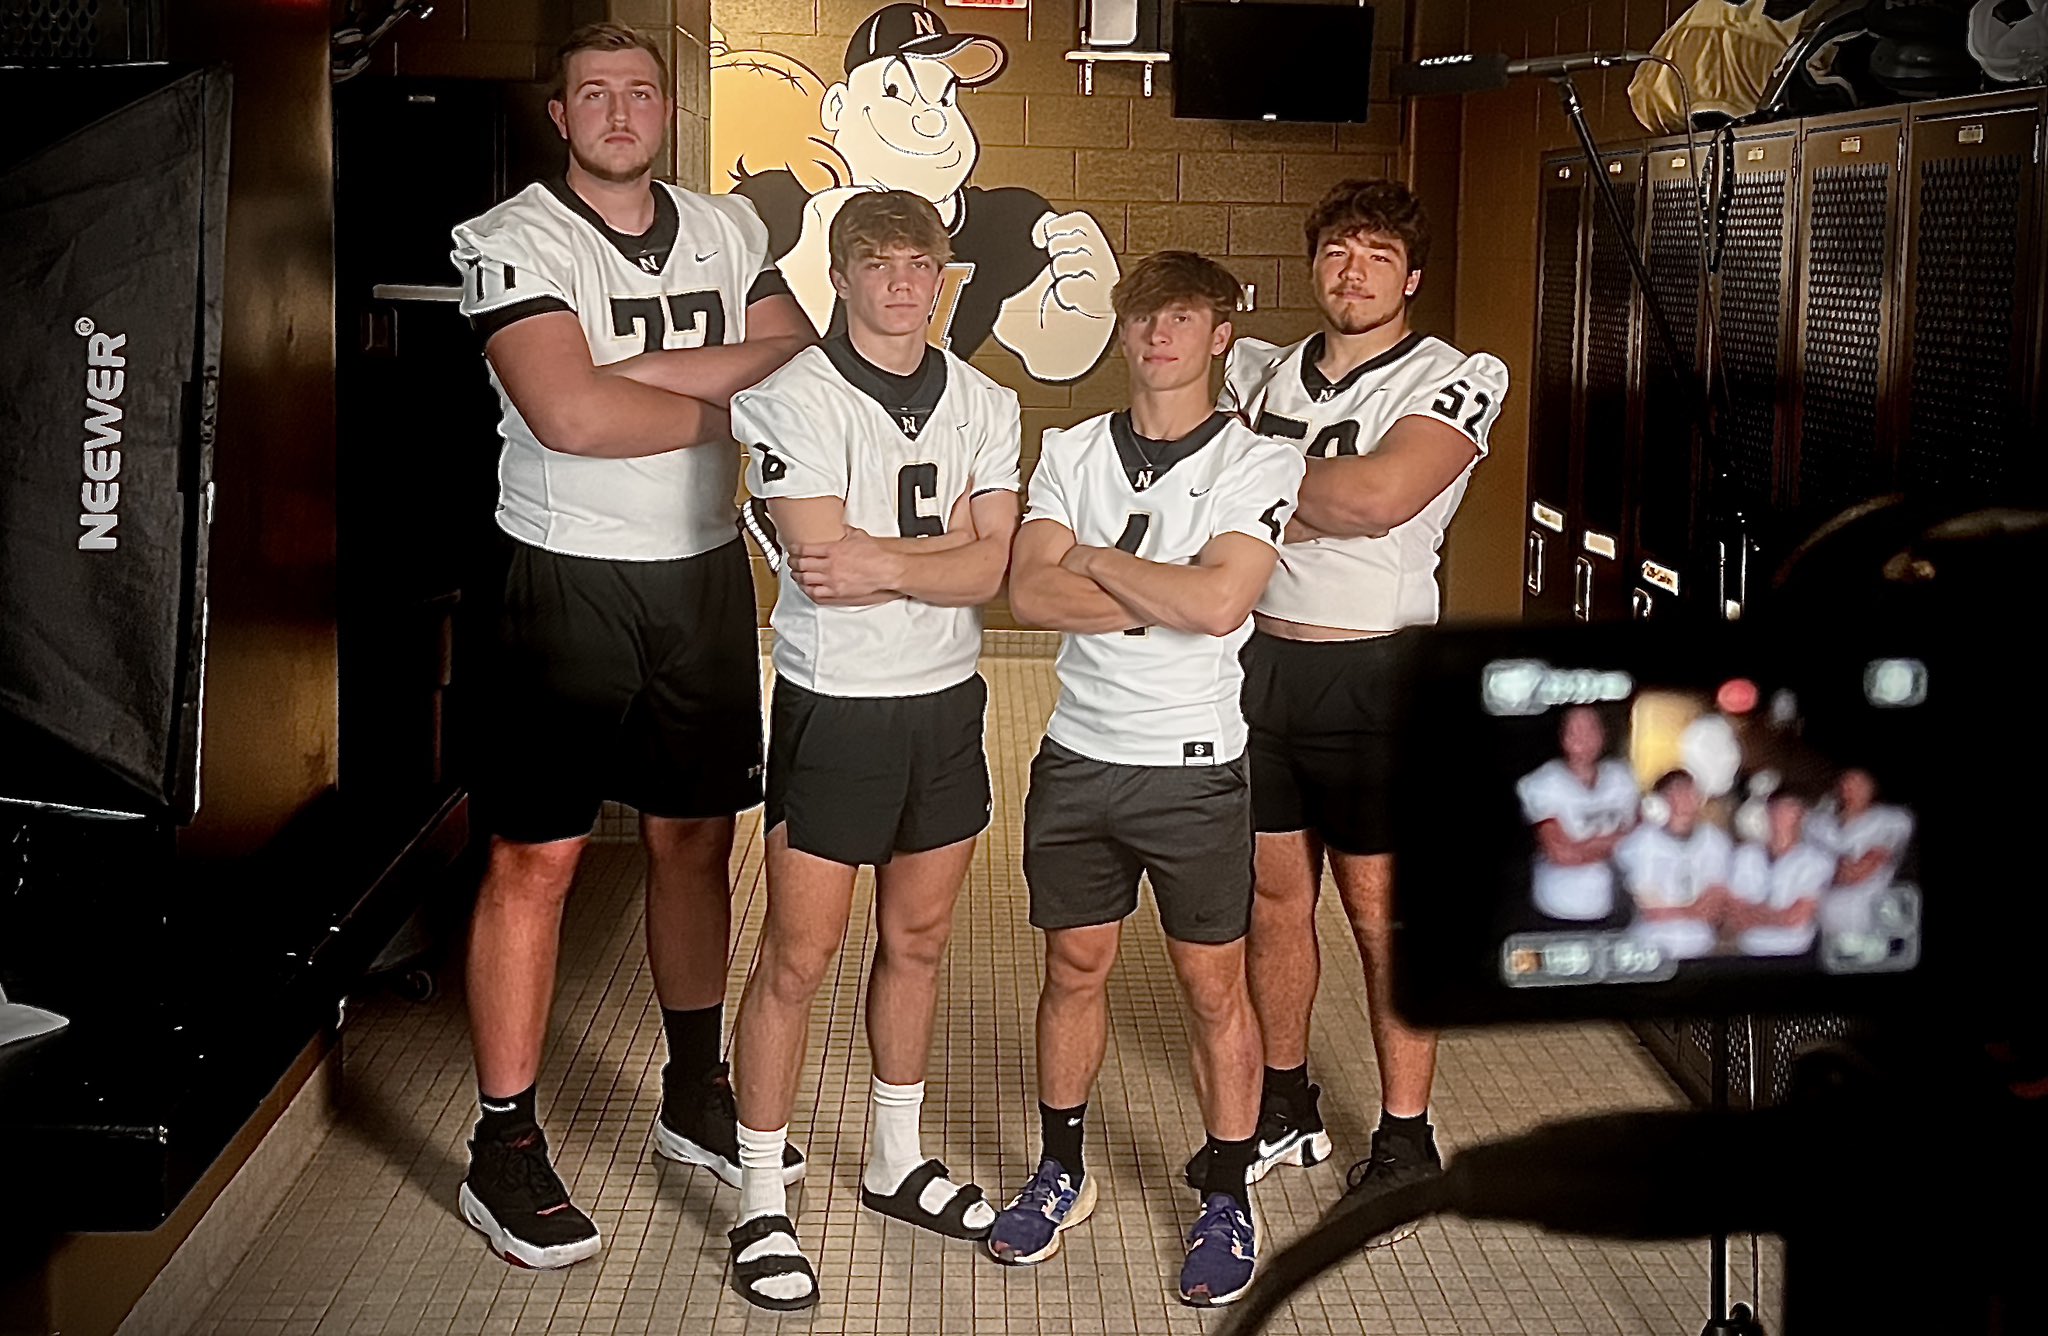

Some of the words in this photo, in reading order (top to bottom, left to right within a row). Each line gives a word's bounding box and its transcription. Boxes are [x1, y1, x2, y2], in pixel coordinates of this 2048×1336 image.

[912, 11, 935, 35] N
[638, 255, 660, 271] N
[1317, 388, 1336, 402] N
[1431, 379, 1492, 442] 52
[901, 416, 919, 434] N
[78, 332, 127, 550] NEEWER
[1134, 470, 1154, 488] N
[1194, 743, 1205, 756] S
